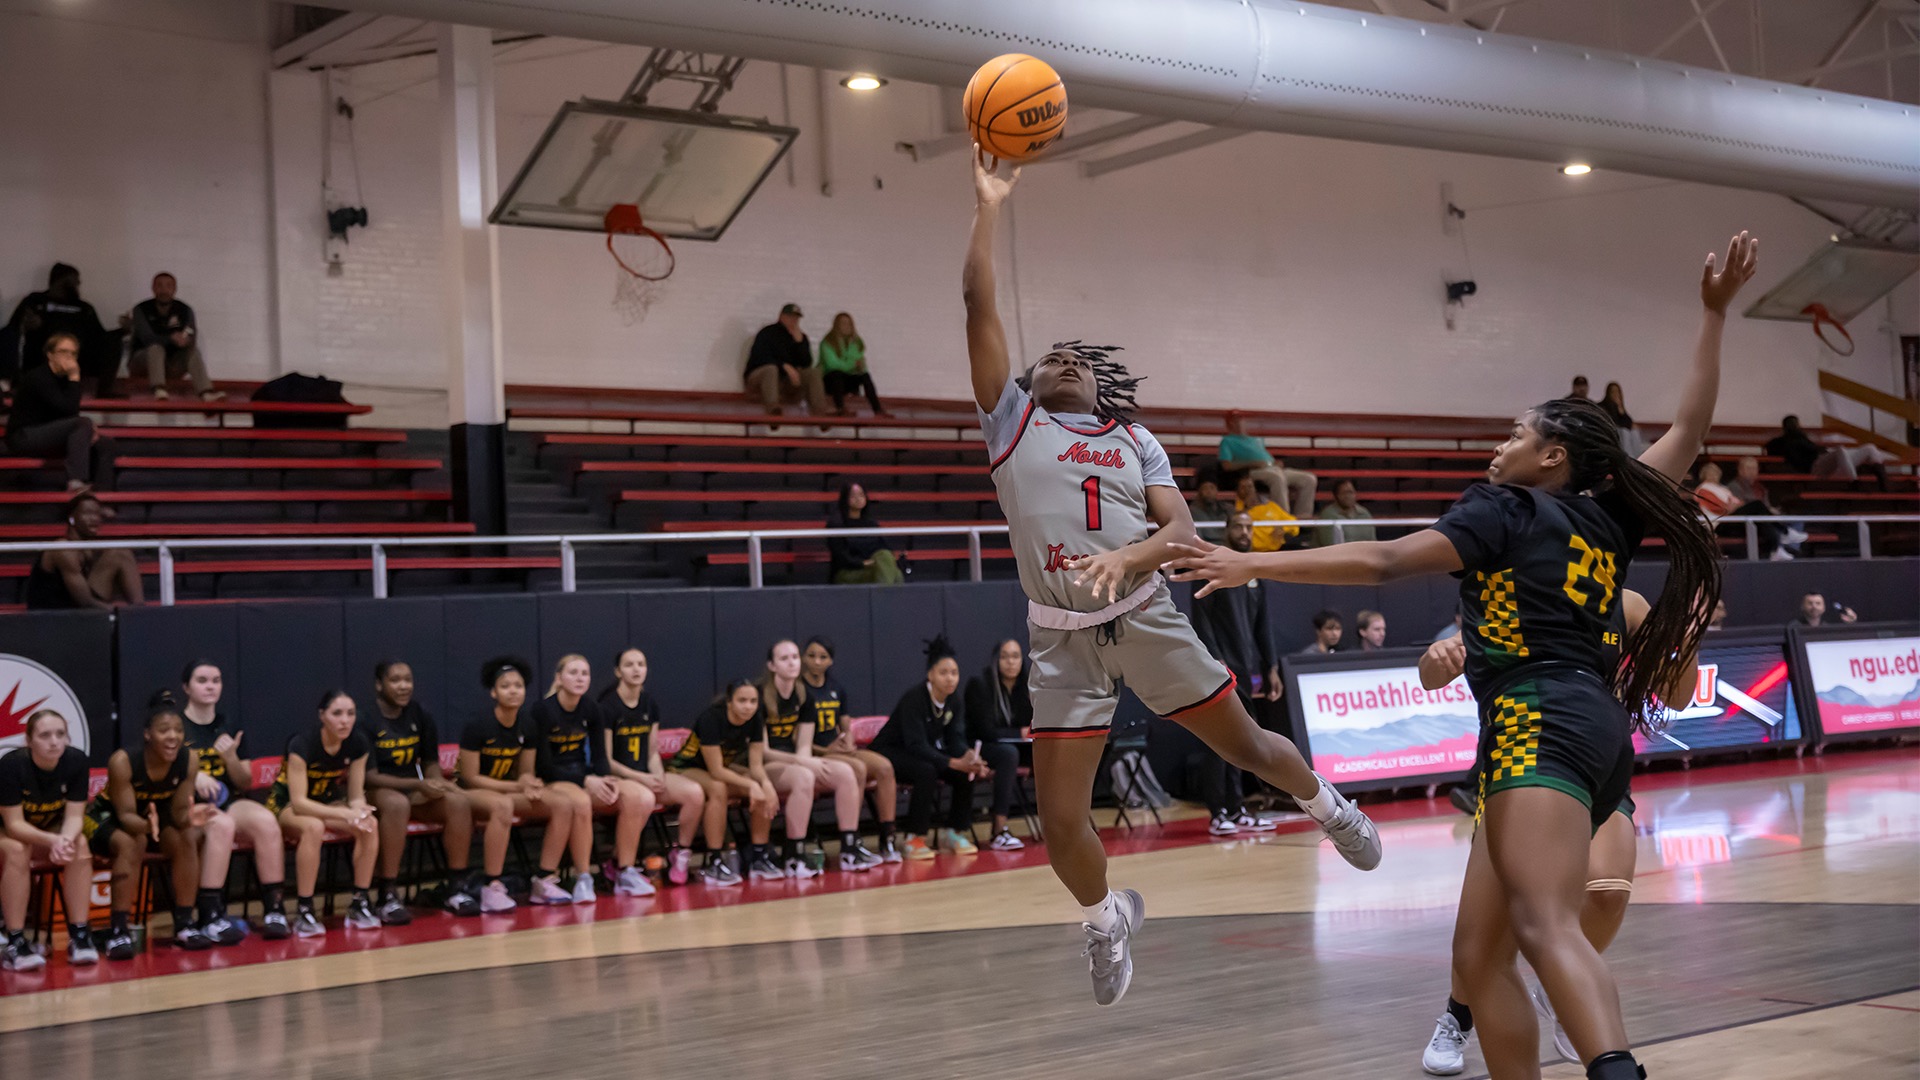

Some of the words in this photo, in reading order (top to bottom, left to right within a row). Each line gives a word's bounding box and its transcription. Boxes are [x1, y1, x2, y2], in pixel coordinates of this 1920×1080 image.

[1016, 101, 1066, 128] Wilso
[1057, 441, 1126, 469] North
[1081, 475, 1102, 531] 1
[1562, 533, 1617, 614] 24
[1602, 632, 1619, 646] AE
[1849, 648, 1920, 682] ngu.ed
[628, 736, 640, 761] 4
[1333, 755, 1398, 773] ACADEMICALLY
[1399, 752, 1446, 767] EXCELLENT
[1455, 750, 1477, 762] MISS
